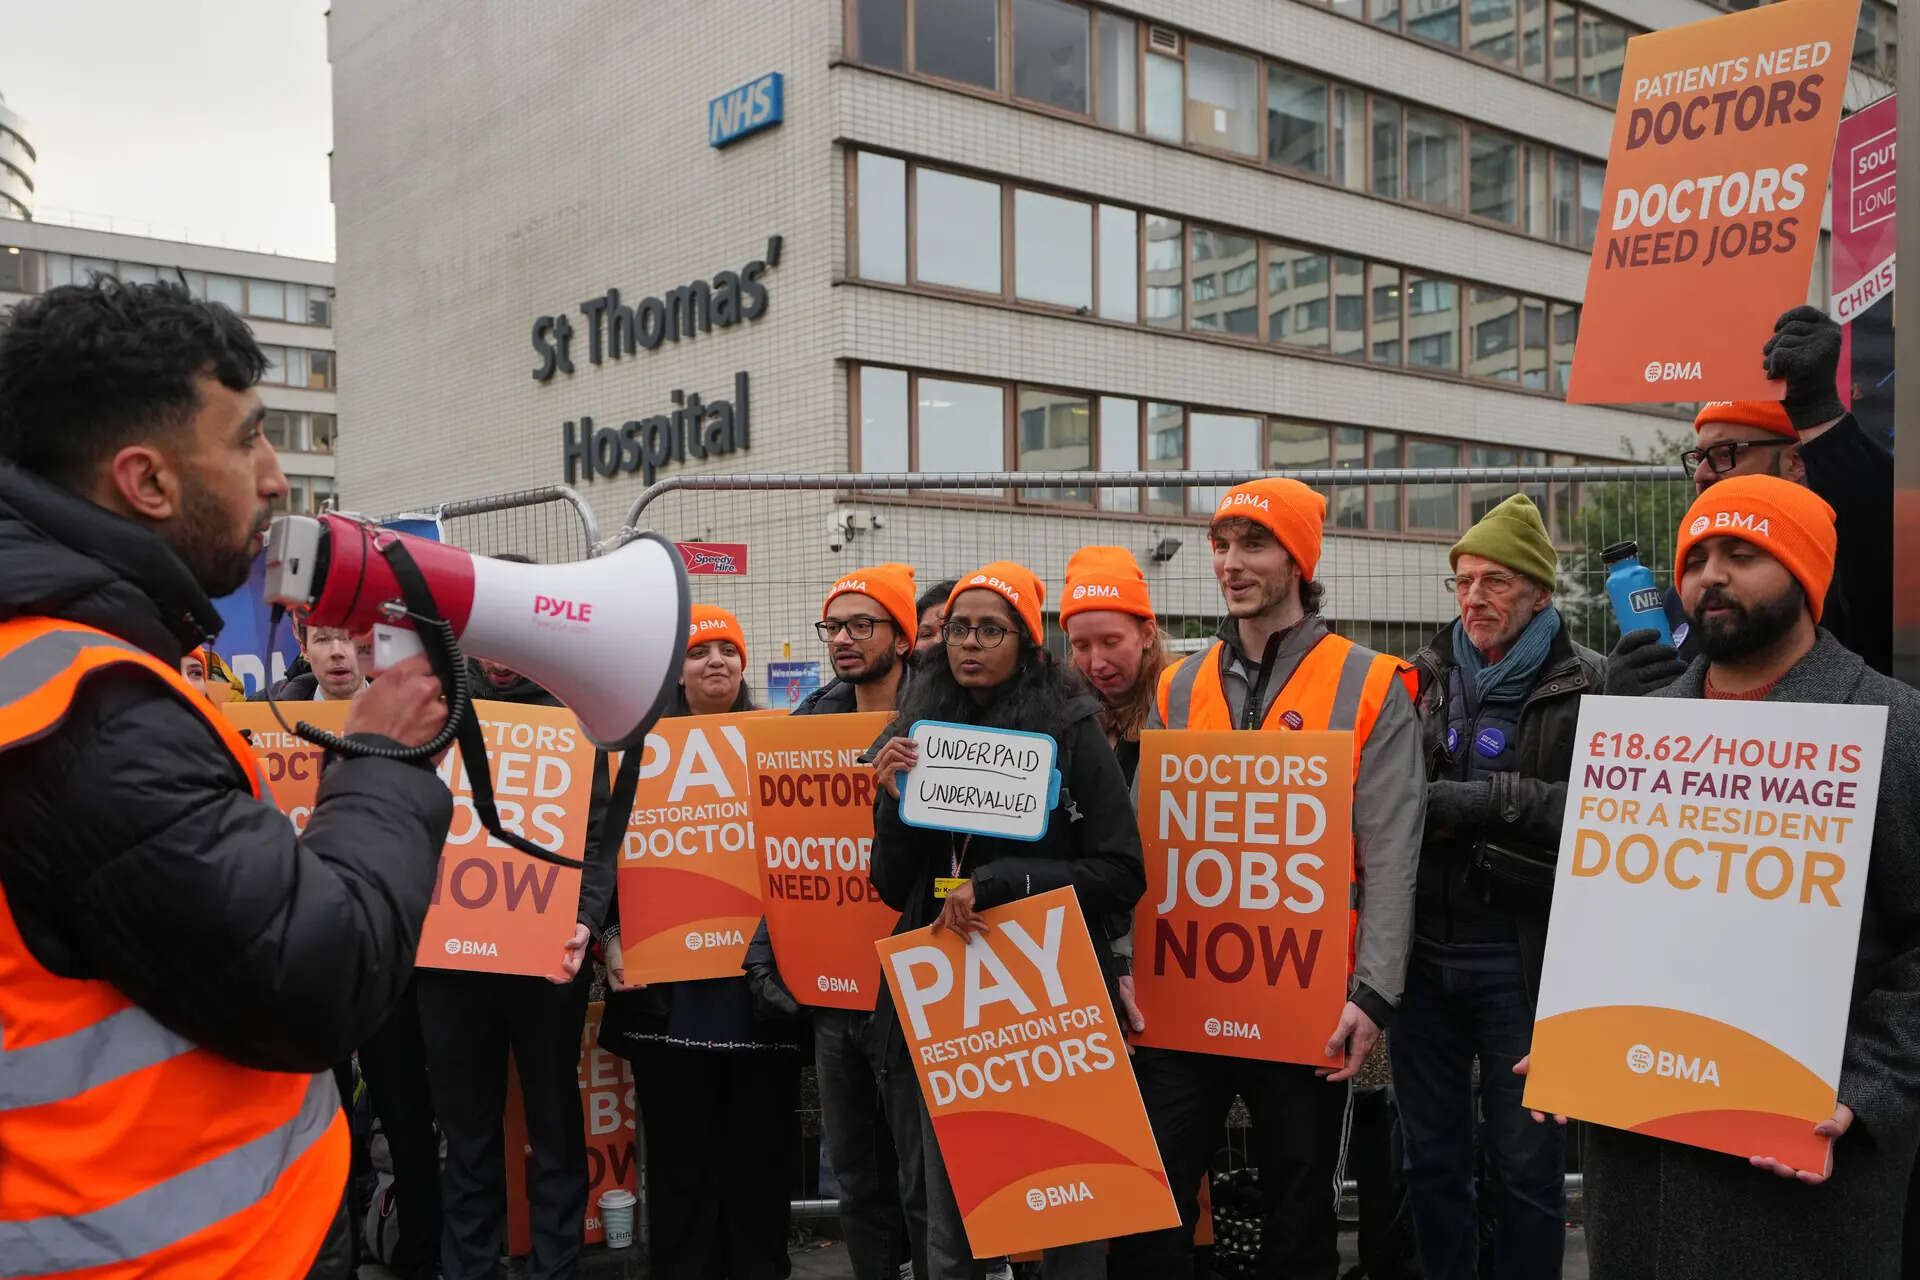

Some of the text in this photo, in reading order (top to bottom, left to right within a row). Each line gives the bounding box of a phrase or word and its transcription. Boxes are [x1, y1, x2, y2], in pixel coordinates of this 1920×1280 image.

[1633, 41, 1831, 102] PATIENTS NEED
[710, 77, 772, 142] NHS
[1626, 74, 1824, 150] DOCTORS
[1612, 164, 1808, 230] DOCTORS
[1605, 217, 1799, 269] NEED JOBS
[1838, 260, 1895, 317] CHRIS
[532, 235, 783, 381] St Thomas'
[1663, 361, 1702, 380] BMA
[563, 371, 749, 487] Hospital
[1234, 493, 1269, 512] BMA
[1715, 511, 1770, 537] BMA
[695, 553, 733, 564] Speedy
[714, 563, 735, 572] Hire
[839, 581, 866, 592] BMA
[988, 577, 1020, 604] BMA
[1087, 585, 1120, 598] BMA
[1635, 591, 1664, 610] NH
[700, 619, 728, 630] BMA
[757, 750, 833, 769] PATIENTS
[926, 736, 1039, 772] UNDERPAID
[1589, 731, 1863, 773] £18.62/HOUR IS
[1161, 754, 1328, 787] DOCTORS
[1583, 764, 1857, 808] NOT A FAIR WAGE
[920, 780, 1037, 813] UNDERVALUED
[445, 796, 567, 852] OBS
[1159, 790, 1327, 846] NEED
[1579, 796, 1853, 843] FOR A RESIDENT
[1157, 848, 1325, 915] JOBS
[1571, 828, 1846, 907] DOCTOR
[768, 873, 830, 900] NEED
[462, 940, 498, 957] BMA
[705, 930, 744, 948] BMA
[1154, 918, 1323, 989] NOW
[830, 977, 858, 993] BMA
[890, 906, 1066, 1041] PAY
[919, 1005, 1104, 1065] RESTORATION FOR
[1223, 1021, 1261, 1040] BMA
[928, 1032, 1116, 1107] DOCTORS
[1656, 1050, 1720, 1087] BMA
[1046, 1182, 1094, 1206] BMA
